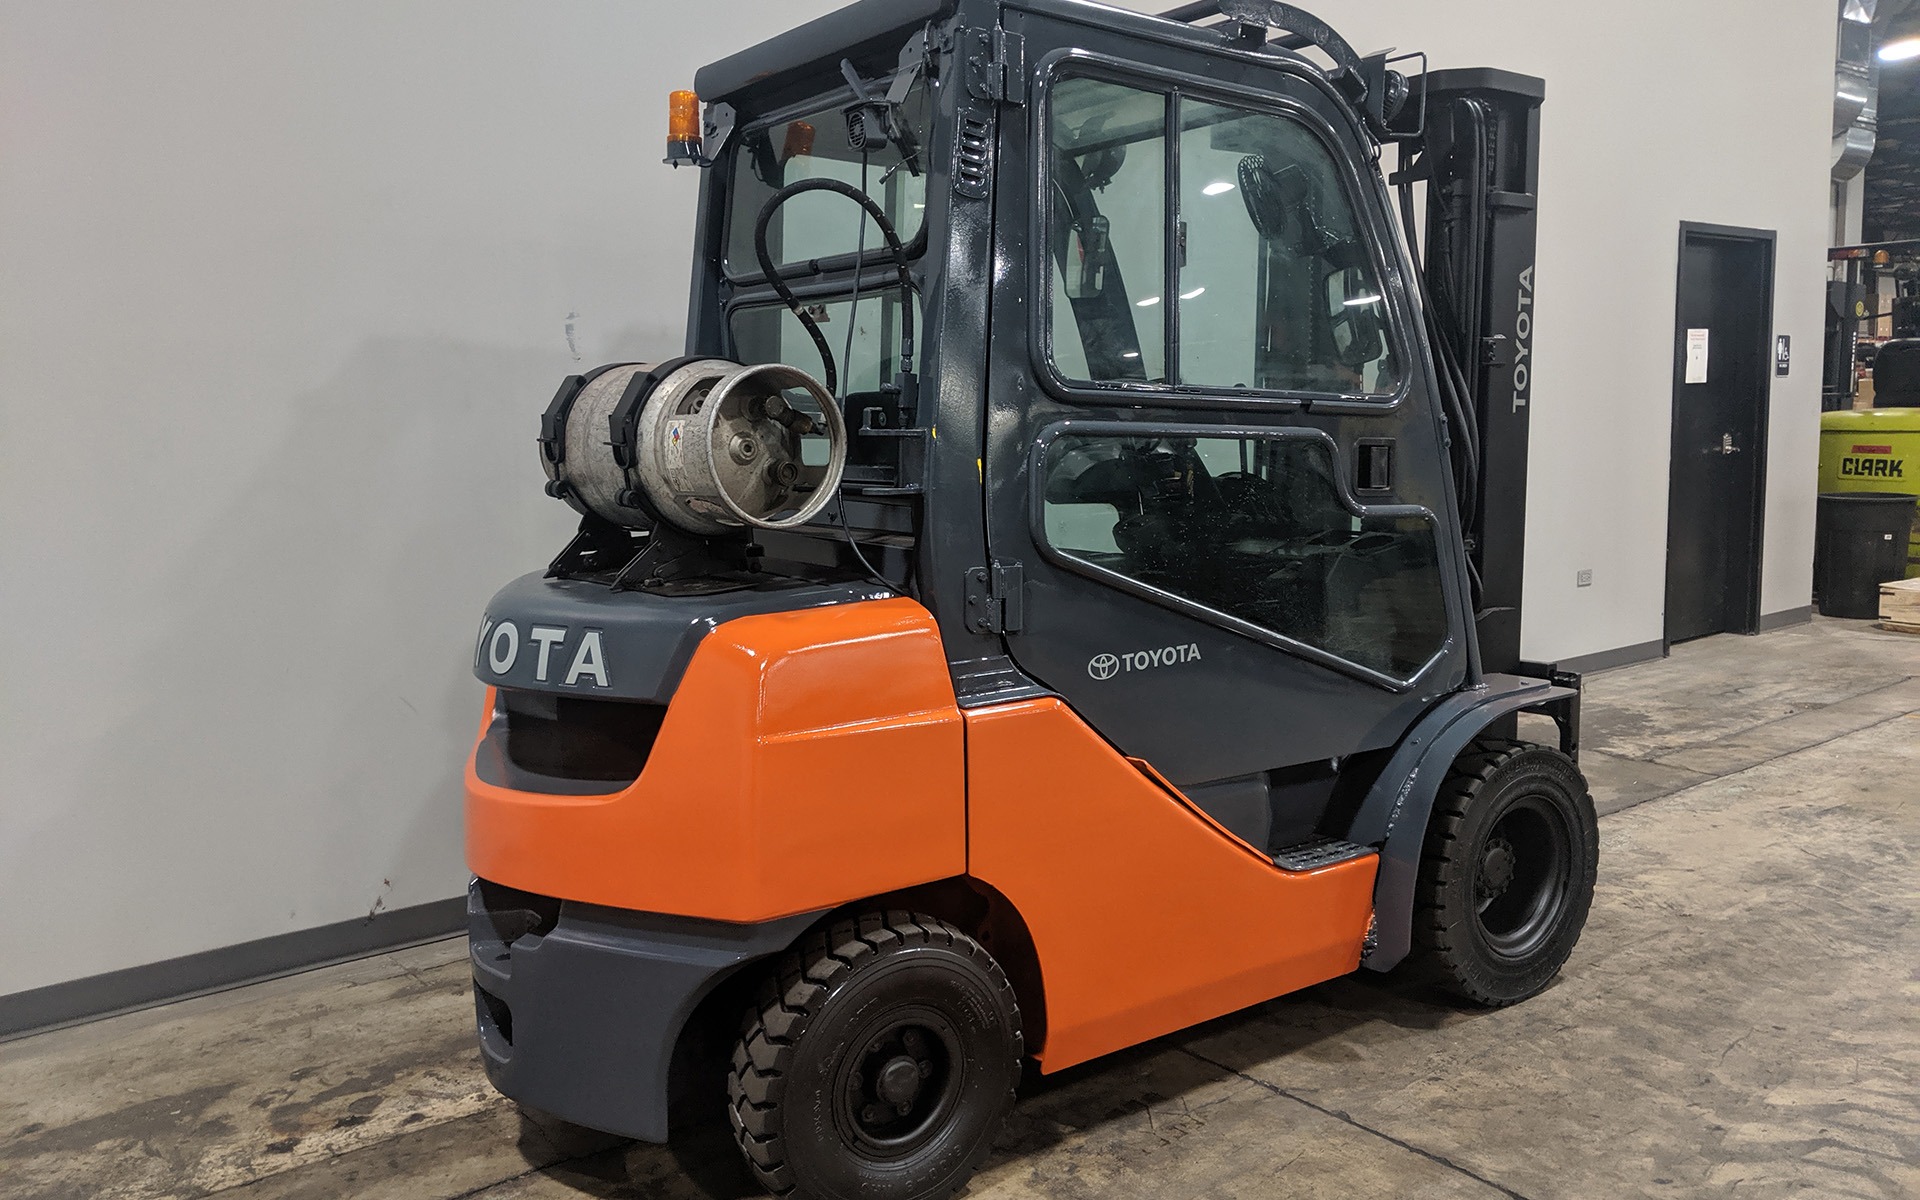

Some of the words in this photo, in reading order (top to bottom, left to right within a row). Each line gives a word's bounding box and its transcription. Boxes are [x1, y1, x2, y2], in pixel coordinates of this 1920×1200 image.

[1512, 265, 1533, 413] TOYOTA
[1842, 458, 1903, 477] CLARK
[1122, 643, 1202, 672] TOYOTA
